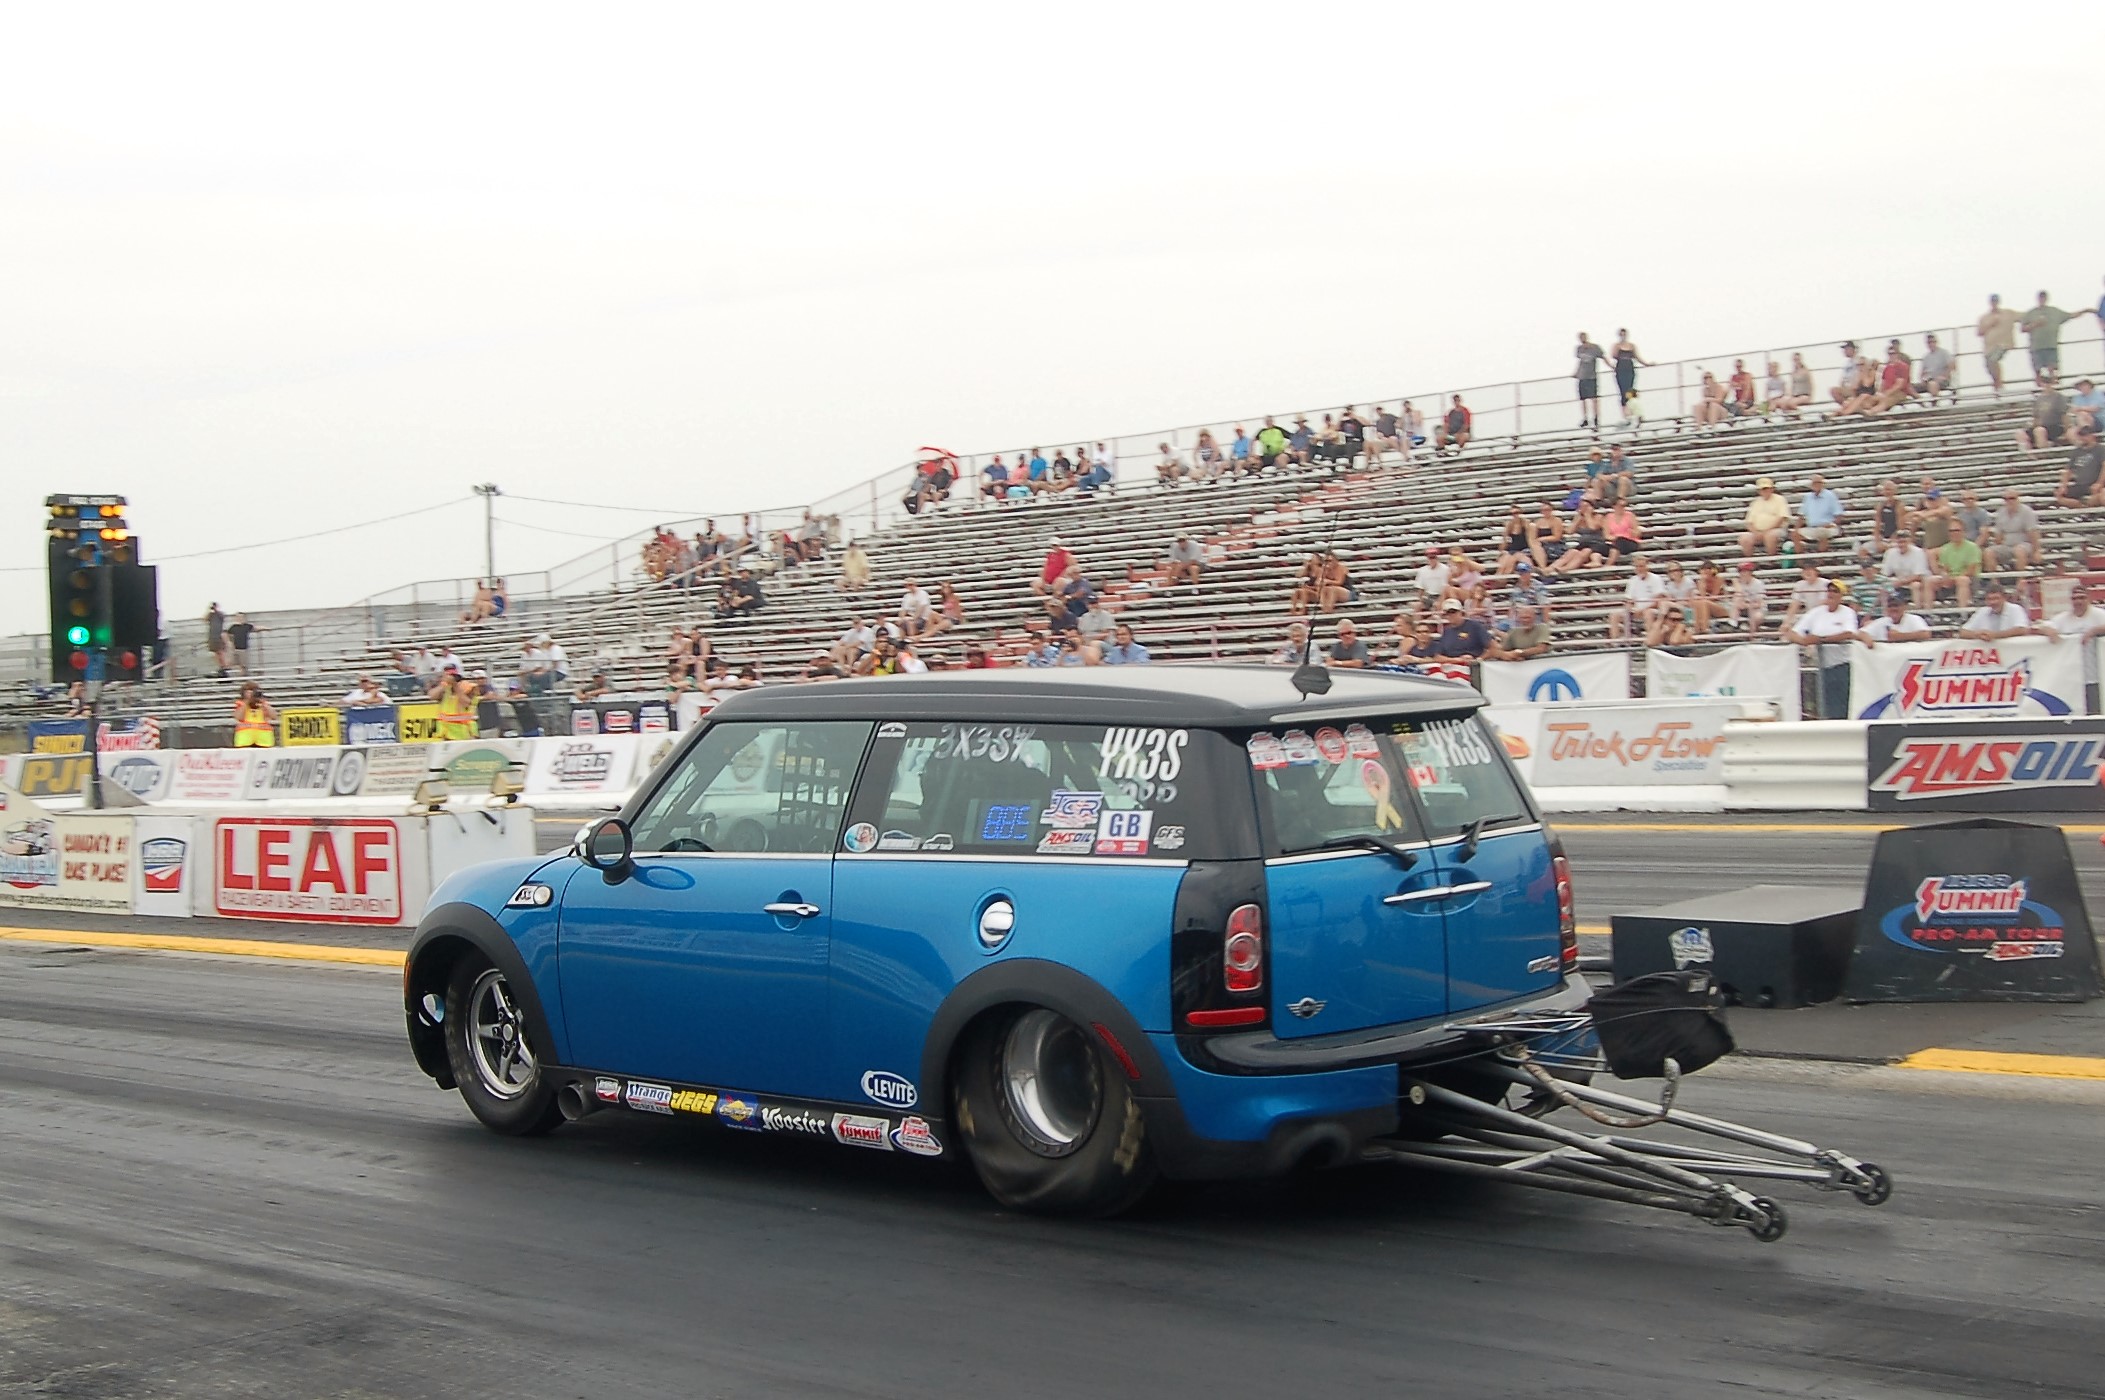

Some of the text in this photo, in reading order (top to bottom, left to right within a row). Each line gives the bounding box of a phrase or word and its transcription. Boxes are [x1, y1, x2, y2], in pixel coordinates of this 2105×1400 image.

[1941, 649, 2000, 667] IHRA
[1902, 663, 2023, 711] SUMMIT
[1100, 728, 1188, 781] YX3S
[1546, 721, 1726, 766] Trick Flow
[1887, 741, 2097, 793] AMSOIL
[1045, 832, 1091, 845] AMSOIL
[224, 829, 389, 895] LEAF
[1921, 879, 2022, 914] SUMMIT
[628, 1083, 671, 1102] Strange
[671, 1090, 718, 1115] JEGS
[861, 1071, 916, 1103] CLEVITE
[762, 1107, 826, 1135] Hoosier
[838, 1118, 881, 1141] SUMMIT
